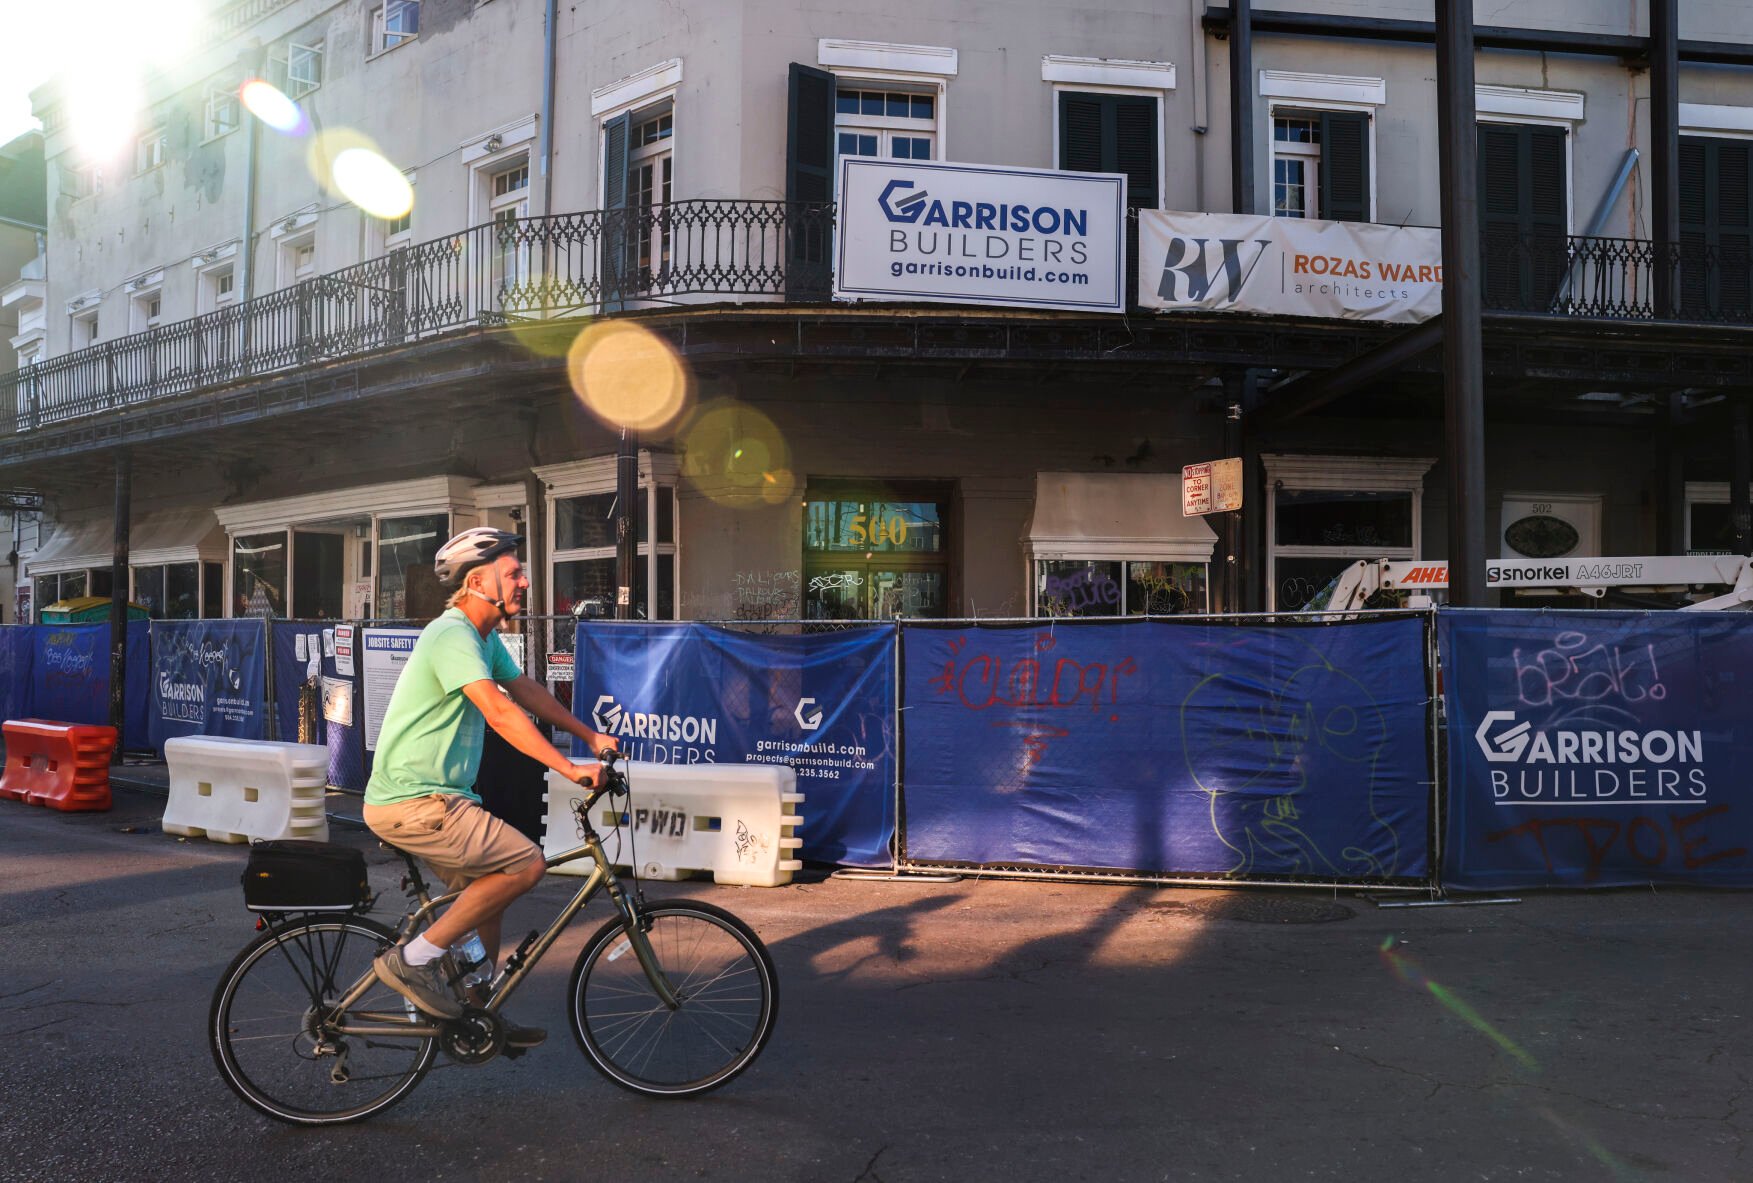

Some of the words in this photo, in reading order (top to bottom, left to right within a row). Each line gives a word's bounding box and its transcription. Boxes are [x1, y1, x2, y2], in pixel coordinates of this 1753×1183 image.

[878, 179, 1088, 237] GARRISON
[889, 229, 1088, 265] BUILDERS
[890, 260, 1089, 285] garrisonbuild.com
[1293, 254, 1371, 280] ROZAS
[1294, 281, 1409, 299] architects
[1186, 484, 1209, 493] CORNER
[1186, 498, 1209, 507] ANYTIME
[1532, 503, 1552, 514] 502
[848, 515, 908, 545] 500
[1502, 565, 1569, 581] snorkel
[1575, 563, 1643, 580] A46JRT
[368, 637, 390, 649] JOBSITE
[390, 637, 412, 649] SAFETY
[159, 672, 204, 702] GARRISON
[162, 701, 204, 721] BUILDERS
[591, 695, 717, 745] GARRISON
[756, 740, 866, 756] garrisonbuild.com
[1474, 710, 1704, 764] GARRISON
[746, 753, 875, 770] projects@garrisonbuild.com
[793, 767, 840, 779] .235.3562
[1490, 768, 1707, 798] BUILDERS
[634, 808, 687, 837] PWD
